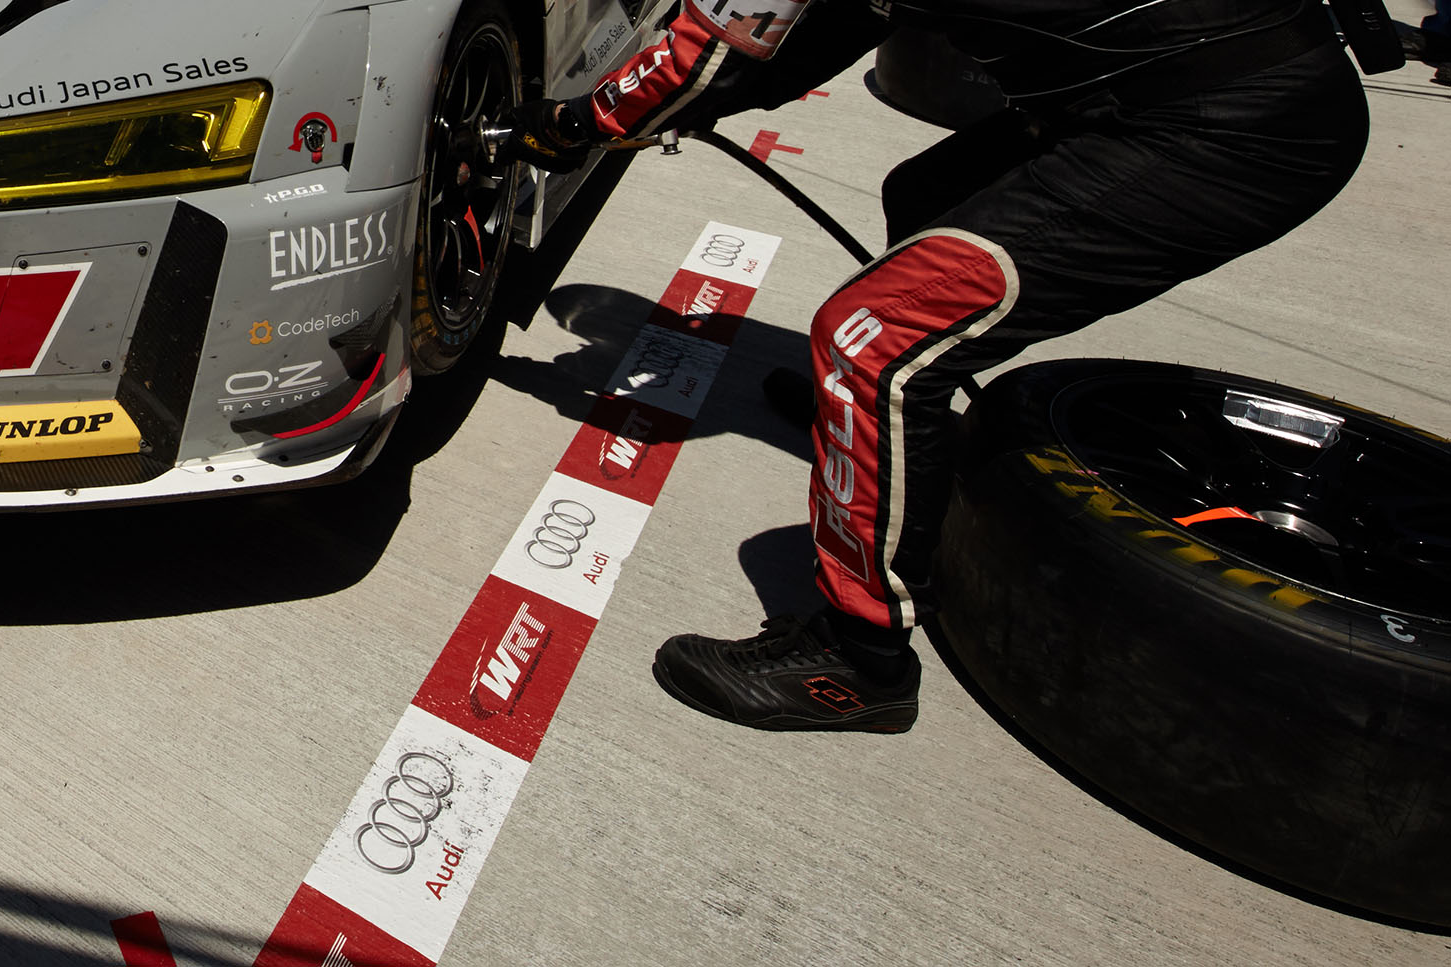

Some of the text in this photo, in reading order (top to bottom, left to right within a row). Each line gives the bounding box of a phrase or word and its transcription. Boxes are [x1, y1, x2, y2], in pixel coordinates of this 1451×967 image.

[57, 71, 153, 103] Japan
[162, 56, 249, 83] Sales
[269, 210, 388, 278] ENDLESS
[743, 257, 760, 274] Audi
[686, 280, 726, 320] WRT
[276, 308, 361, 337] CodeTech
[223, 389, 322, 411] RACING
[677, 375, 698, 399] Audi
[605, 408, 654, 470] WRT
[582, 551, 611, 585] Audi
[478, 600, 547, 702] WRT
[423, 840, 466, 902] Audi
